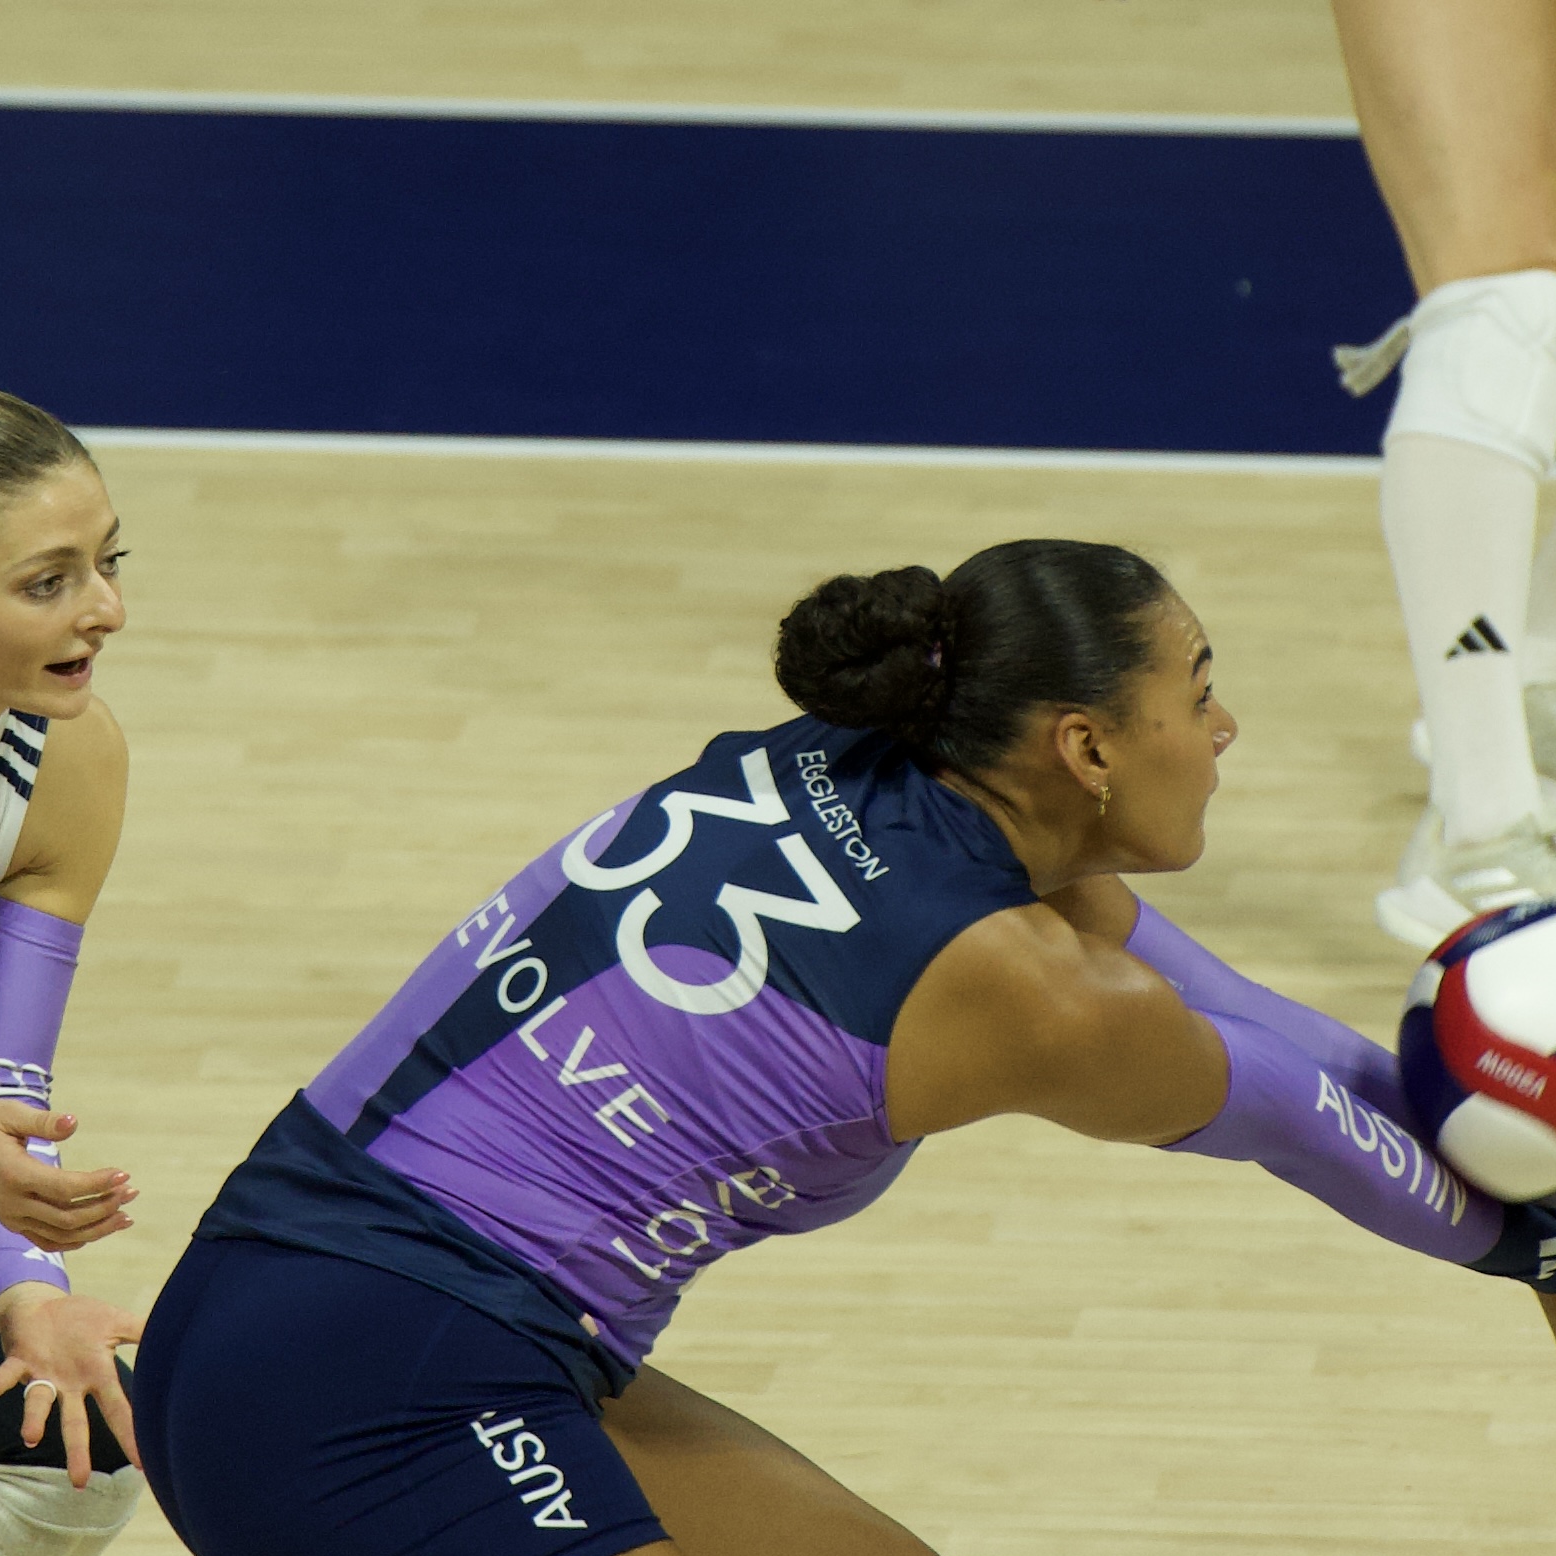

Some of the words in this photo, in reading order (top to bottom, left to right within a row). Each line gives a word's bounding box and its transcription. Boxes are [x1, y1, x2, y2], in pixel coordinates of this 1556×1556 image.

[561, 746, 862, 1016] 33
[796, 749, 890, 881] EGGLESTON
[456, 888, 673, 1149] EVOLVE
[470, 1410, 589, 1529] AUST
